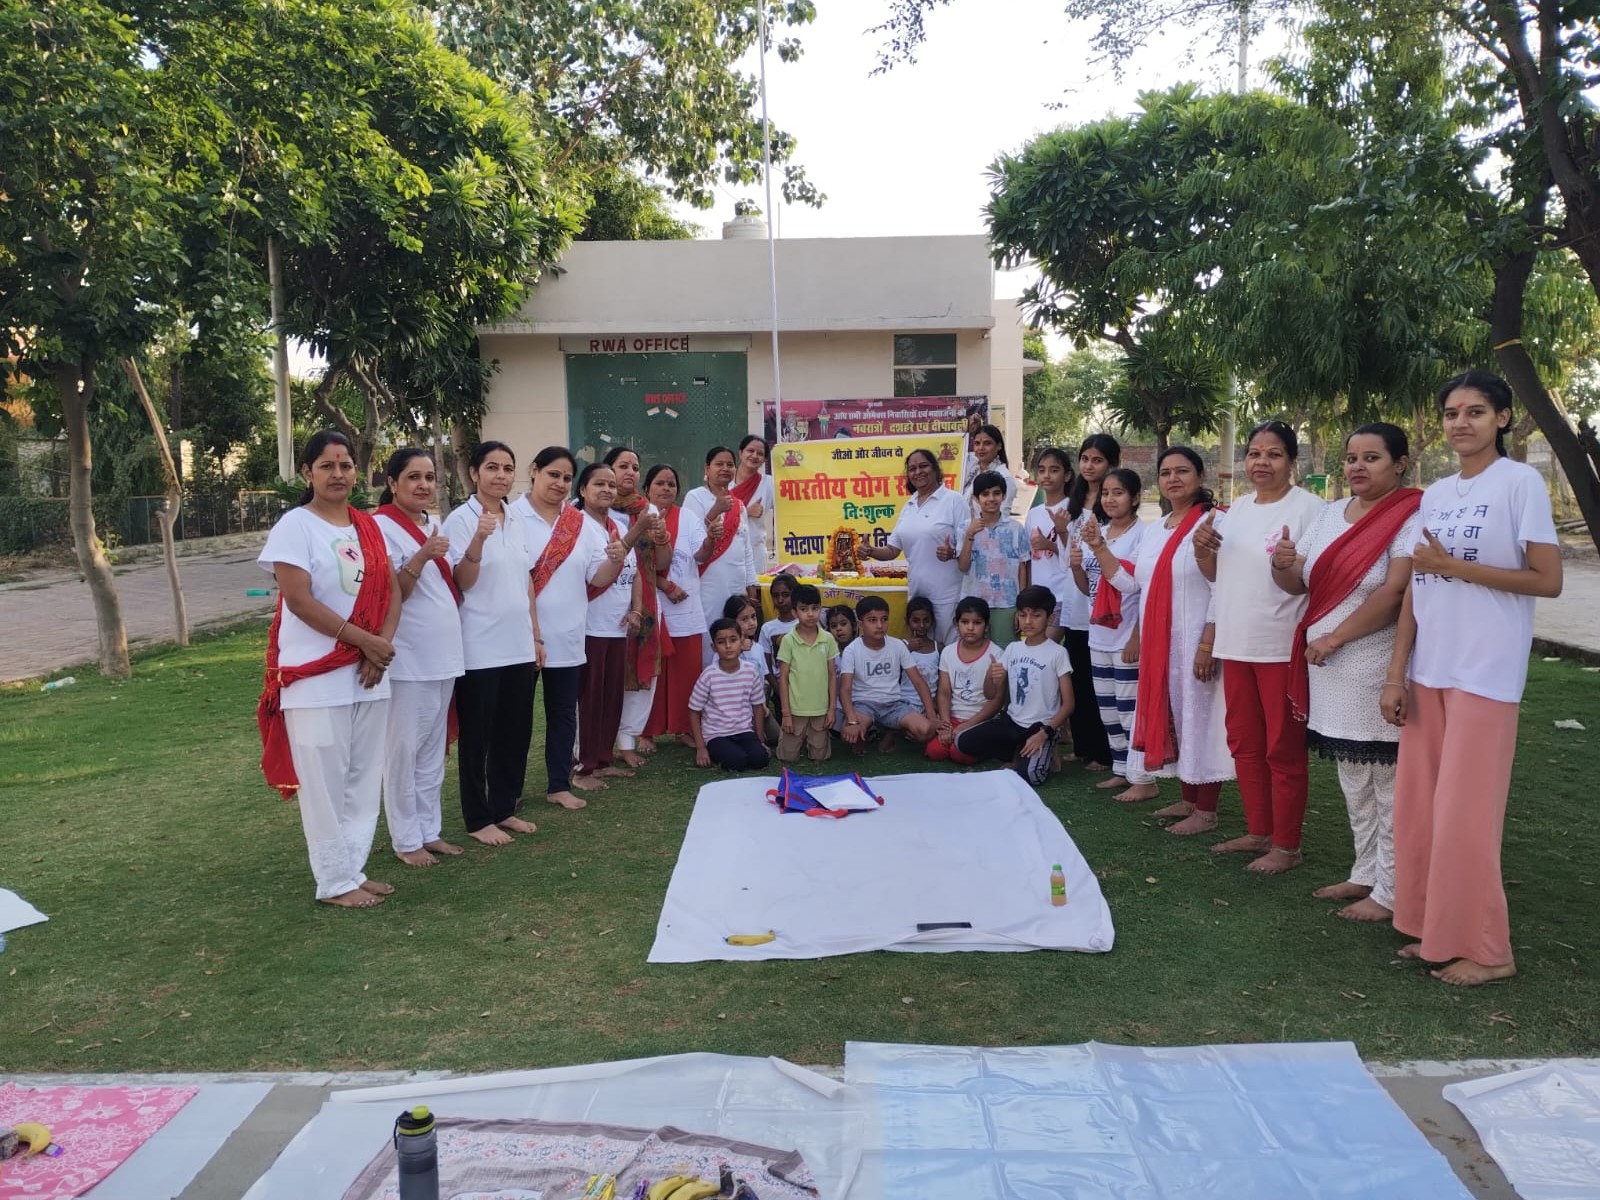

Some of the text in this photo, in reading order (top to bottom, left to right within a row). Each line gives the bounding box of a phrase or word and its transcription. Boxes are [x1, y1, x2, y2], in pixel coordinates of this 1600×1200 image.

[589, 337, 688, 352] RWA OFFICE
[855, 447, 870, 459] और
[872, 446, 893, 458] जीवन
[895, 445, 904, 458] दो
[779, 473, 848, 501] भारतीय
[851, 471, 891, 498] योग
[783, 531, 825, 556] मोटापा
[866, 661, 892, 677] Lee
